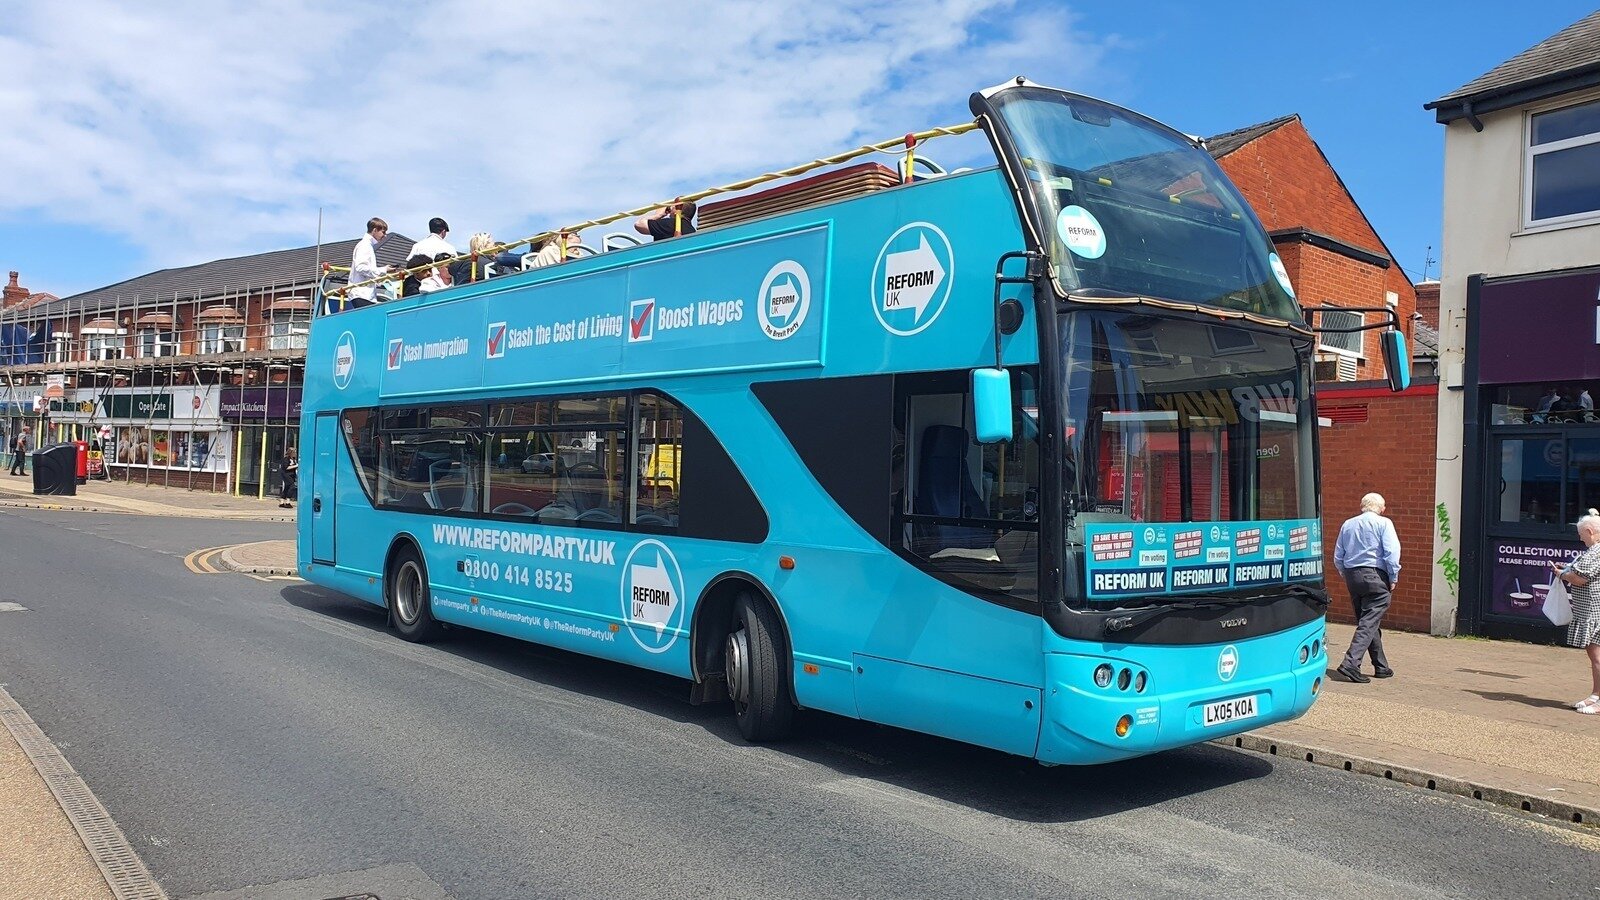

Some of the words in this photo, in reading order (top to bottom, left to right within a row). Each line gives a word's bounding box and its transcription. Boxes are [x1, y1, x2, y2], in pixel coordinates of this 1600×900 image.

[887, 270, 934, 291] REFORM
[771, 295, 796, 306] REFORM
[886, 291, 901, 307] UK
[658, 302, 695, 331] Boost
[698, 299, 744, 326] Wages
[771, 305, 779, 315] UK
[508, 327, 534, 349] Slash
[535, 324, 551, 346] the
[553, 320, 576, 343] Cost
[577, 317, 589, 340] of
[590, 313, 623, 338] Living
[403, 342, 423, 362] Slash
[423, 336, 469, 360] Immigration
[221, 402, 241, 414] Impact
[242, 401, 267, 412] Kitchens
[432, 523, 616, 566] WWW.REFORMPARTY.UK
[1499, 545, 1562, 557] COLLECTION
[1564, 549, 1587, 558] POI
[1141, 554, 1150, 562] I'm
[1150, 553, 1166, 563] voting
[1208, 552, 1216, 560] I'm
[1216, 550, 1229, 560] voting
[1523, 559, 1546, 567] ORDER
[464, 558, 500, 581] 0800
[504, 564, 530, 587] 414
[535, 568, 573, 593] 8525
[1174, 568, 1214, 587] REFORM
[1215, 567, 1228, 583] UK
[1235, 565, 1270, 582] REFORM
[1271, 564, 1283, 579] UK
[1288, 560, 1317, 577] REFORM
[1094, 572, 1147, 590] REFORM
[1149, 571, 1164, 588] UK
[633, 586, 670, 607] REFORM
[633, 602, 645, 618] UK
[1220, 618, 1248, 628] VOLVO
[1207, 702, 1232, 722] LX05
[1234, 698, 1253, 717] KOA
